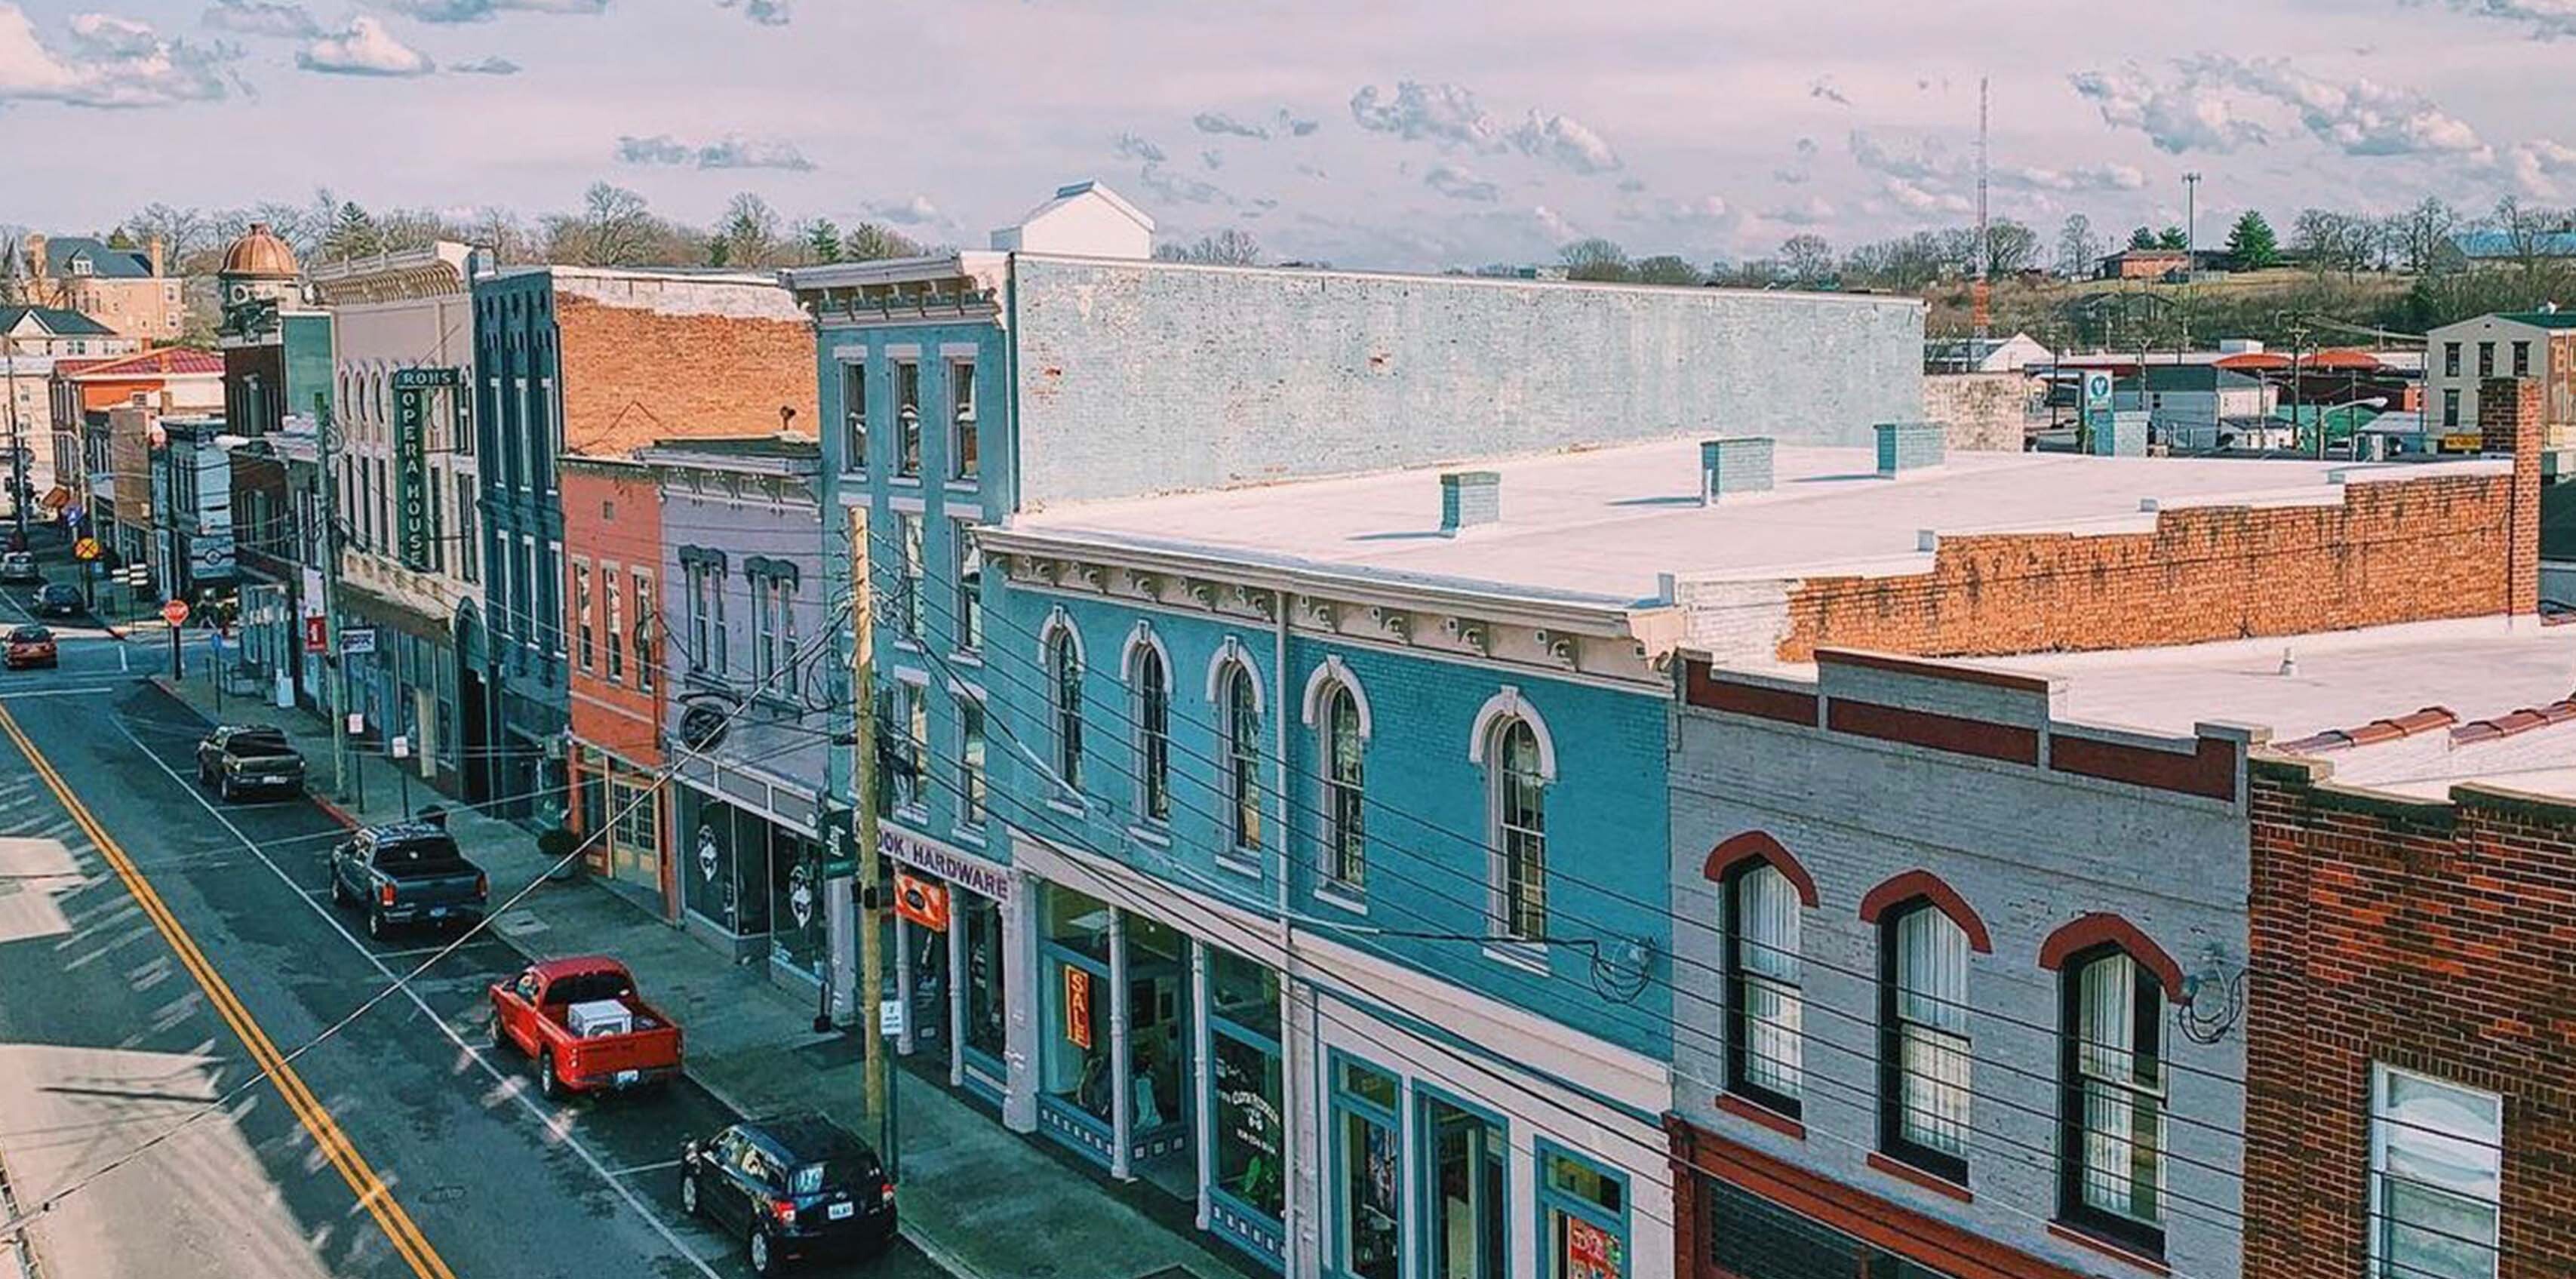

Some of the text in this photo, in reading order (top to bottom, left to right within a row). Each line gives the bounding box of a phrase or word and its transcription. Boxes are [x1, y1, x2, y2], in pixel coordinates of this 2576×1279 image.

[404, 372, 451, 385] ROHS
[402, 392, 422, 566] OPERA HOUSE
[825, 825, 846, 857] play
[913, 843, 1008, 900] HARDWARE
[1071, 974, 1085, 1043] SALE
